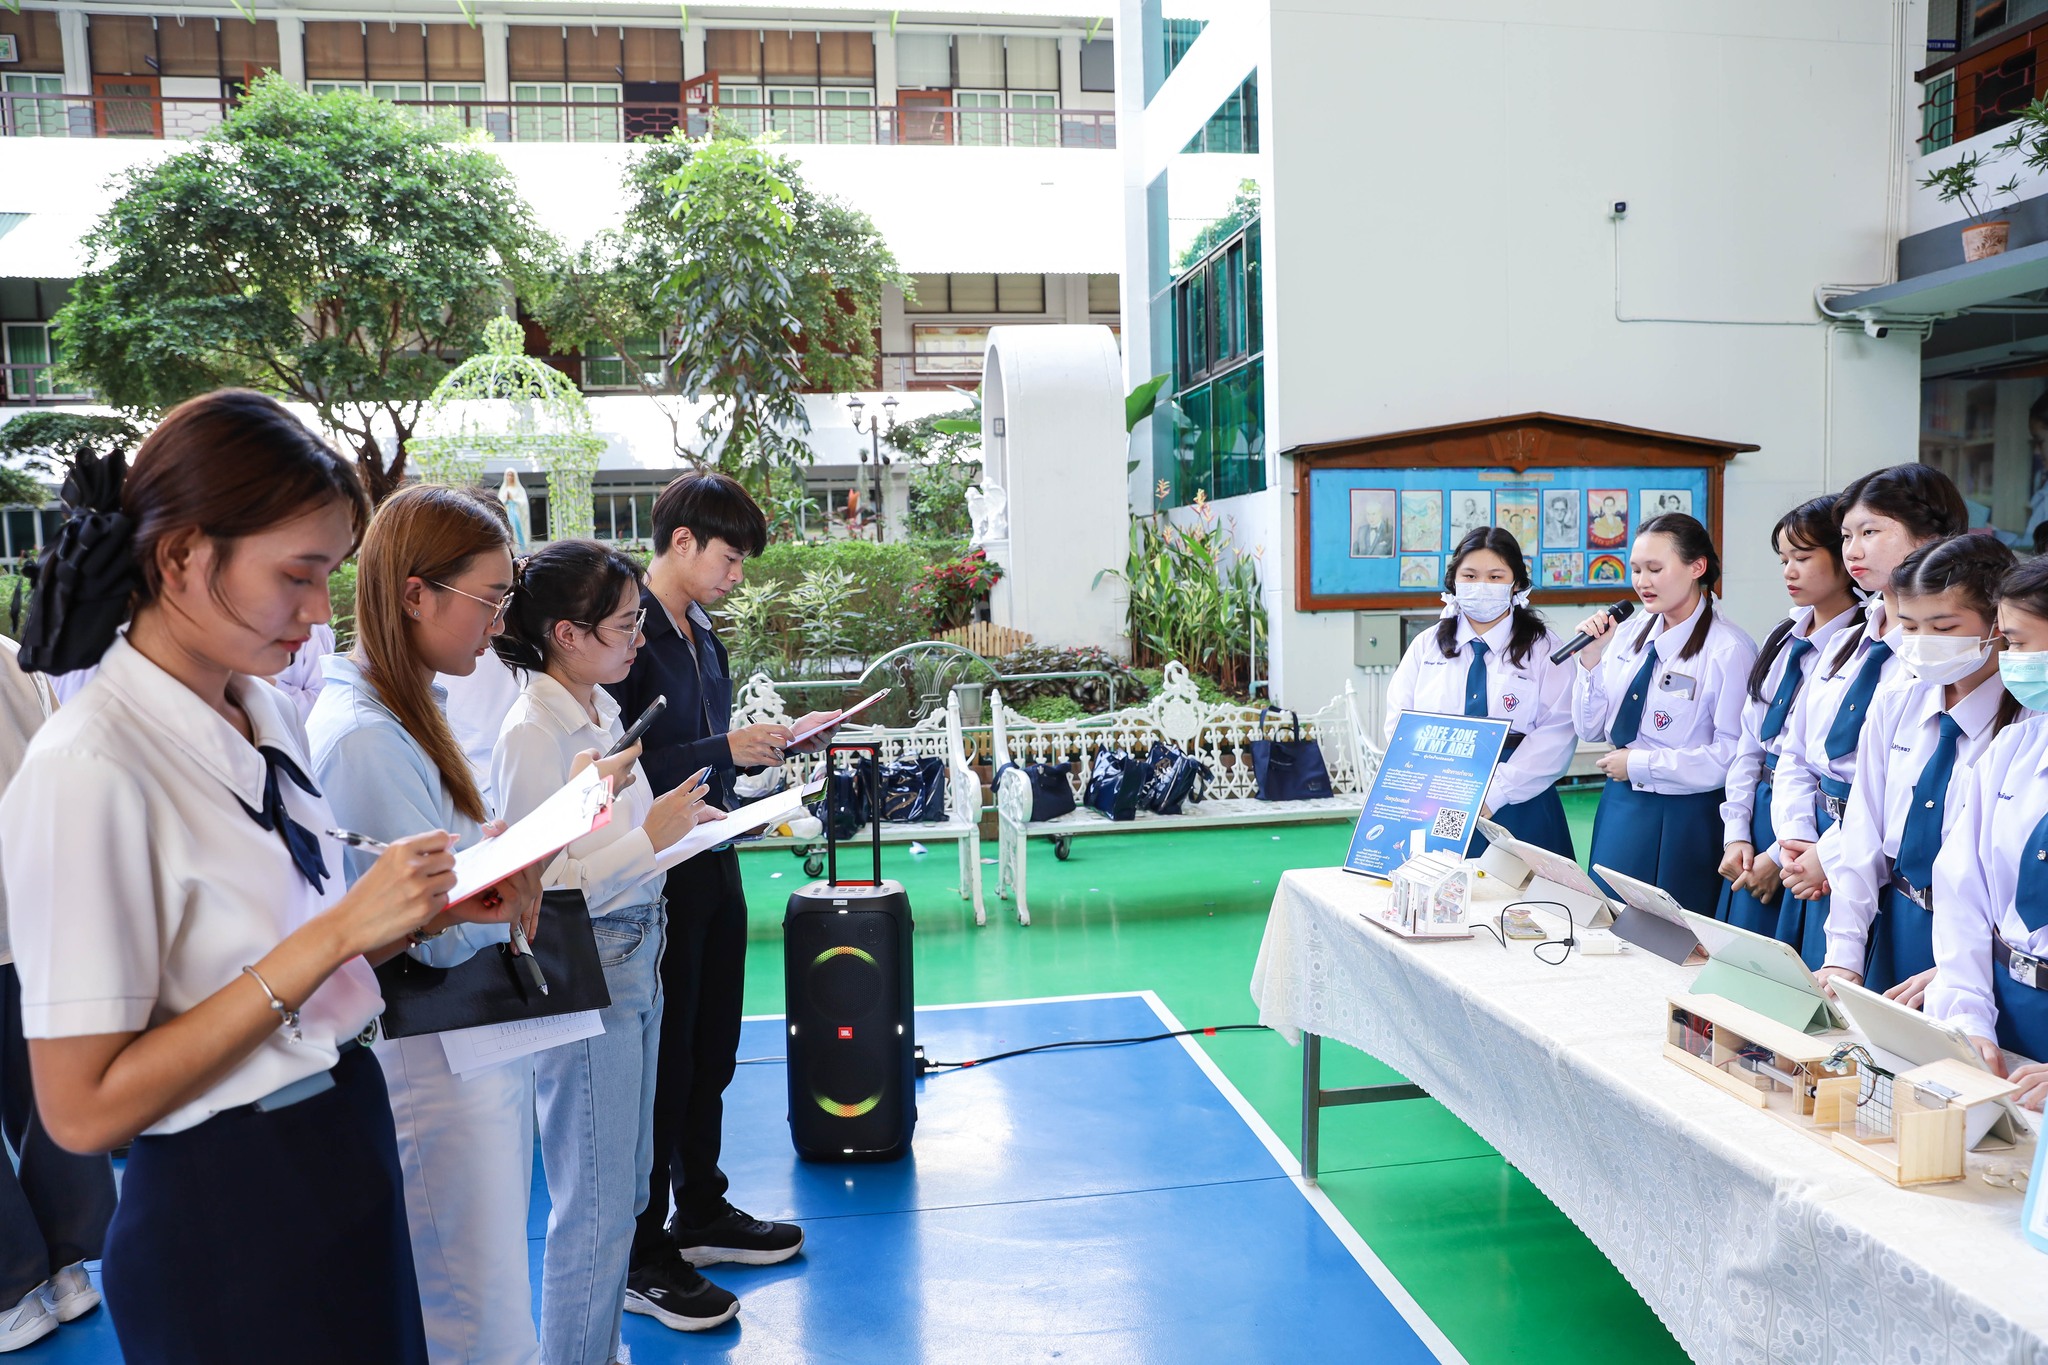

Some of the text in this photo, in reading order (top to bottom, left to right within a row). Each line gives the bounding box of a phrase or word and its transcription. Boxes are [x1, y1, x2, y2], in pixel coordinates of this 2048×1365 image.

[1423, 724, 1479, 743] SAFE ZONE
[1414, 737, 1476, 757] IN MY AREA
